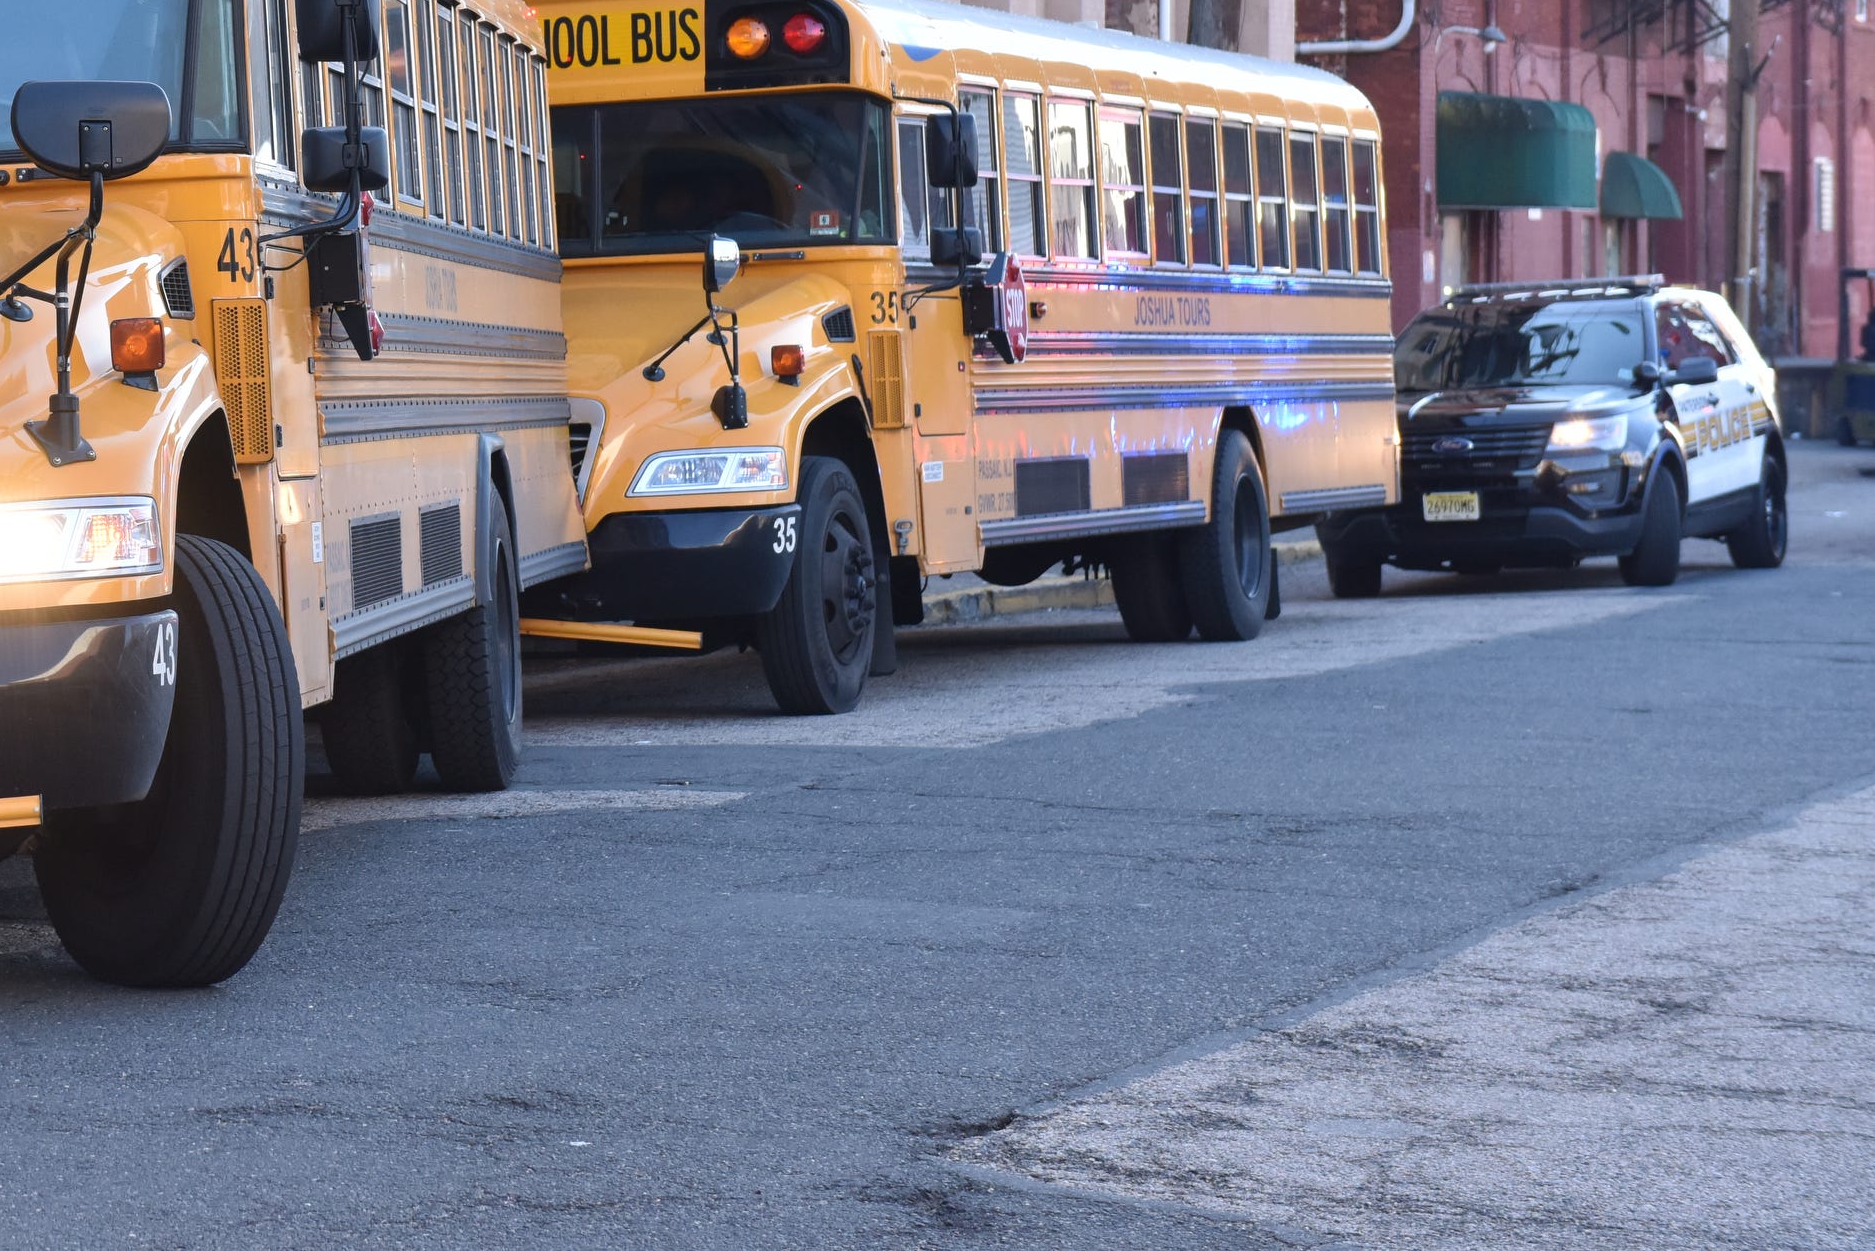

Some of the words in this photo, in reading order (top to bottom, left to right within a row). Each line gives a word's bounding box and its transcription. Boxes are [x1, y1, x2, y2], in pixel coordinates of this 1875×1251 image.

[631, 8, 701, 63] BUS
[217, 227, 255, 283] 43
[870, 291, 899, 324] 35
[1006, 288, 1024, 327] STOP
[1134, 296, 1175, 326] JOSHUA
[1177, 297, 1211, 326] TOURS
[1694, 405, 1751, 456] POLICE
[772, 516, 796, 554] 35
[153, 622, 175, 686] 43
